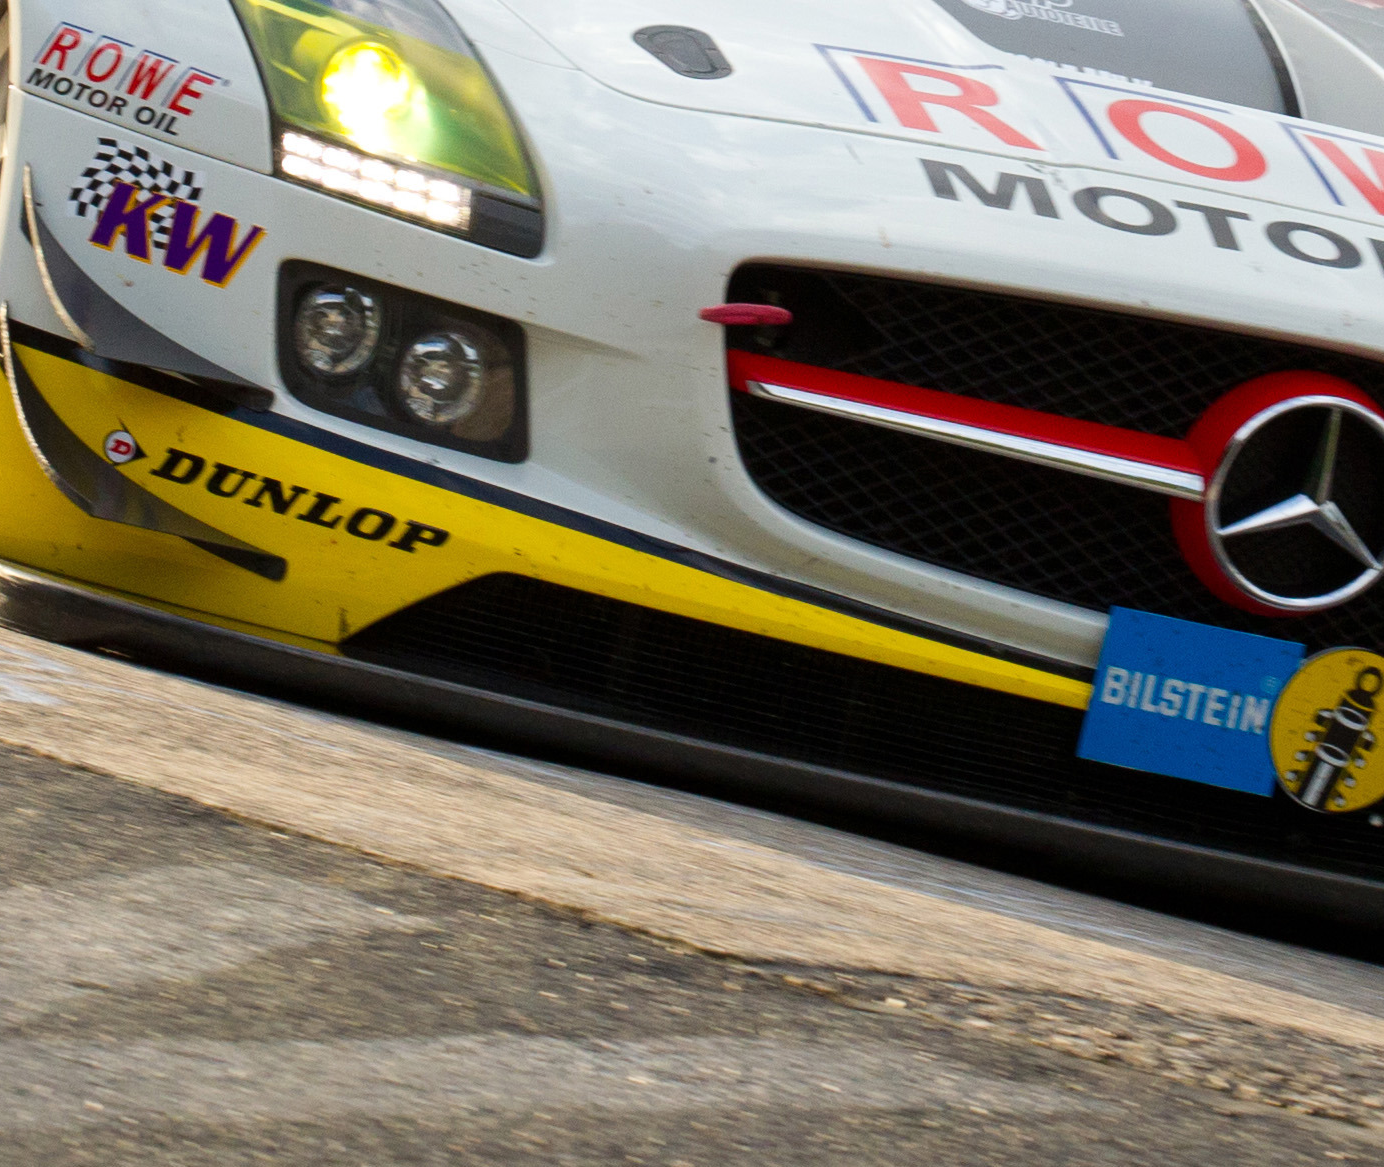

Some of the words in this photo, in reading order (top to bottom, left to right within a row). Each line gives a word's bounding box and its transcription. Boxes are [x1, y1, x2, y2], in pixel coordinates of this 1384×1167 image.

[26, 67, 127, 116] MOTOR
[134, 103, 180, 136] OIL
[38, 25, 219, 116] ROWE
[89, 178, 267, 290] KW
[150, 446, 451, 554] DUNLOP
[1100, 665, 1271, 736] BILSTEIN
